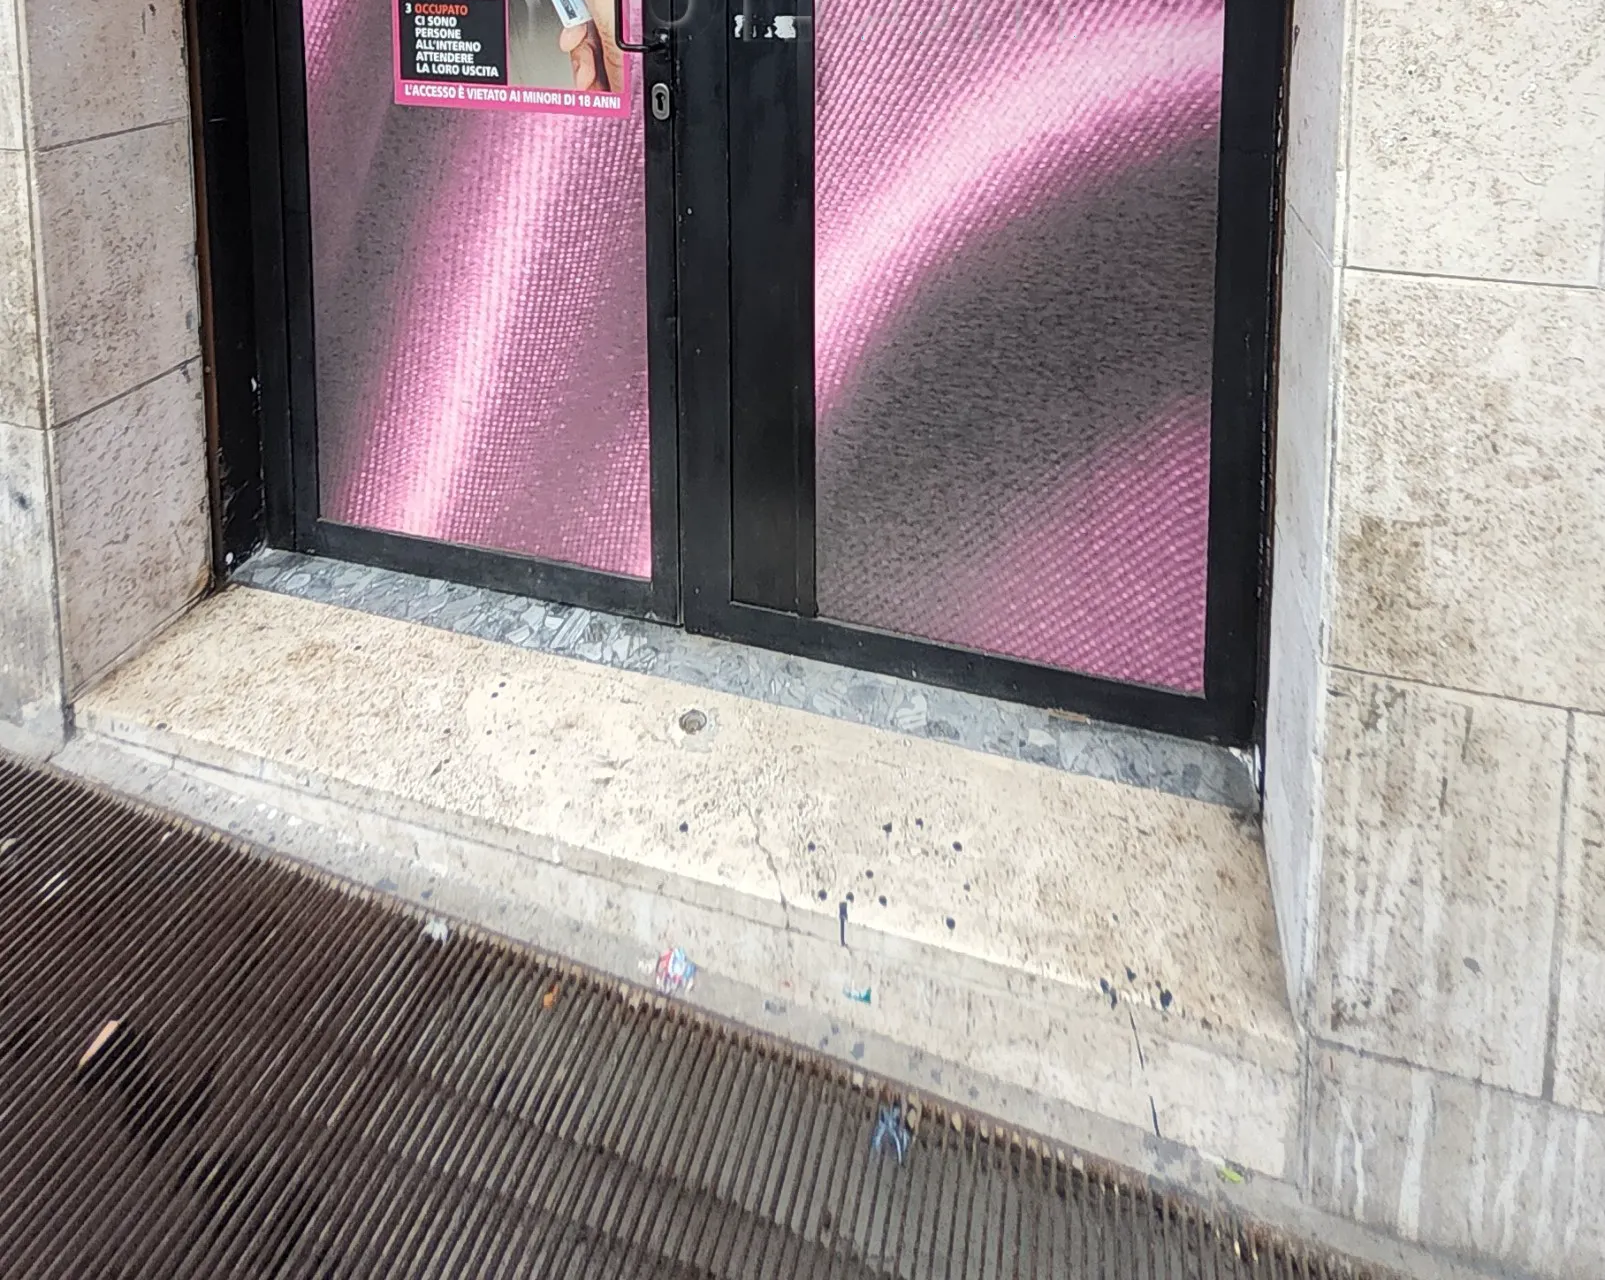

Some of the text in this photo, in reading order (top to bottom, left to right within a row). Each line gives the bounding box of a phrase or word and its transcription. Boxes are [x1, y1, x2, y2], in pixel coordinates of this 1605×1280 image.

[405, 3, 468, 15] 3 OCCUPATO
[414, 15, 457, 27] CI SONO
[415, 28, 461, 39] PERSONE
[415, 39, 481, 52] ALL'INTERNO
[416, 51, 474, 63] ATTENDERE
[416, 63, 499, 77] LA LORO USCITA
[404, 84, 621, 109] L'ACCESSO È VIETATO AI MINORI DI 18 ANNI
